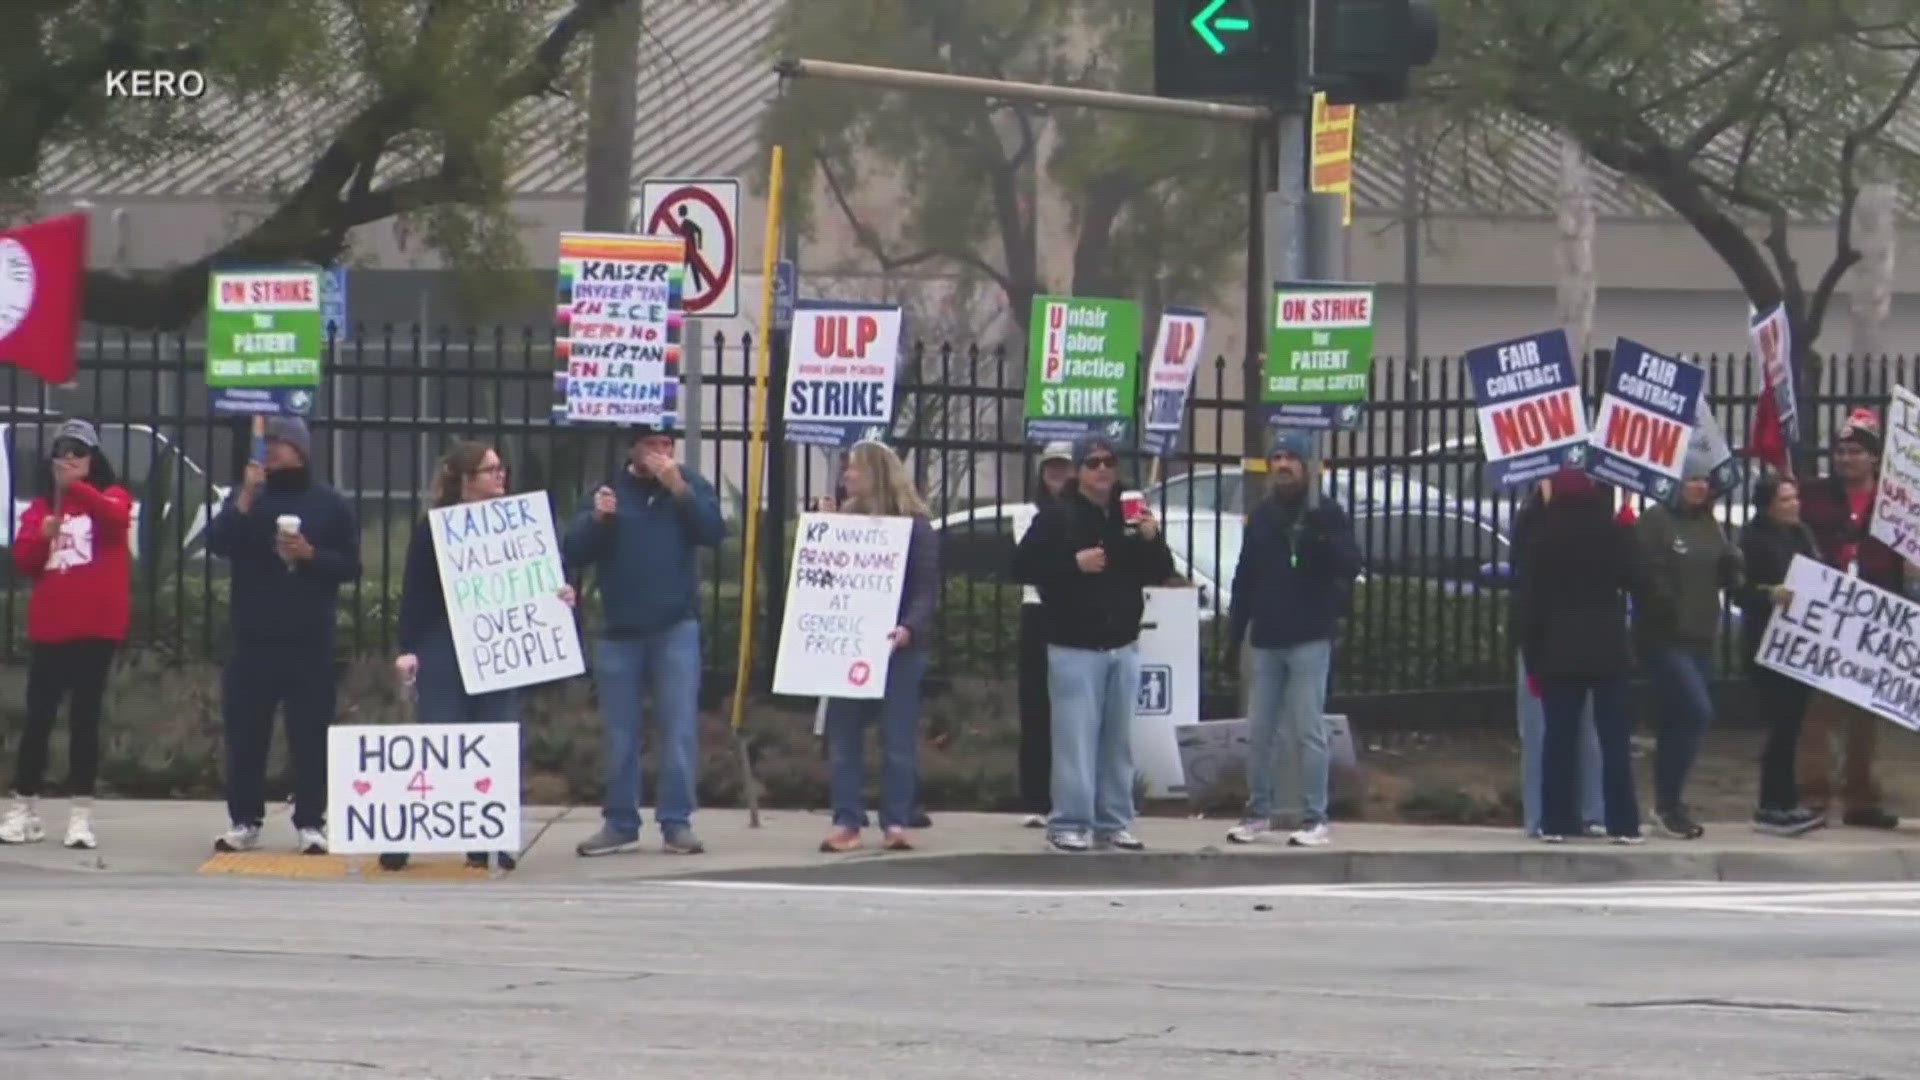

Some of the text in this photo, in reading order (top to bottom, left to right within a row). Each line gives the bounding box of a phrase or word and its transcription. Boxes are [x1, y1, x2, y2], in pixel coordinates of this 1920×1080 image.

[582, 260, 669, 282] KAISER
[221, 279, 313, 304] ON STRIKE
[573, 301, 602, 314] EN
[1282, 297, 1367, 322] ON STRIKE
[630, 324, 658, 341] NO
[814, 315, 878, 359] ULP
[569, 362, 634, 378] EN LA
[1290, 350, 1350, 371] PATIENT
[1497, 340, 1541, 373] FAIR
[1637, 351, 1680, 390] FAIR
[790, 379, 884, 417] STRIKE
[1486, 363, 1562, 399] CONTRACT
[1617, 372, 1688, 415] CONTRACT
[1041, 387, 1119, 415] STRIKE
[1491, 390, 1577, 457] NOW
[1604, 404, 1684, 468] NOW
[441, 498, 538, 546] KAISER
[806, 522, 891, 546] KP WANTS
[447, 530, 547, 573] VALUES
[799, 547, 901, 571] BRAND NAME
[828, 594, 851, 611] AT
[472, 602, 548, 643] OVER
[797, 613, 866, 635] GENERIC
[1779, 600, 1857, 640] LET
[473, 625, 568, 682] PEOPLE
[805, 634, 864, 657] PRICES
[1763, 627, 1842, 679] HEAR
[359, 733, 492, 773] HONK
[405, 770, 435, 800] 4
[346, 800, 507, 842] NURSES
